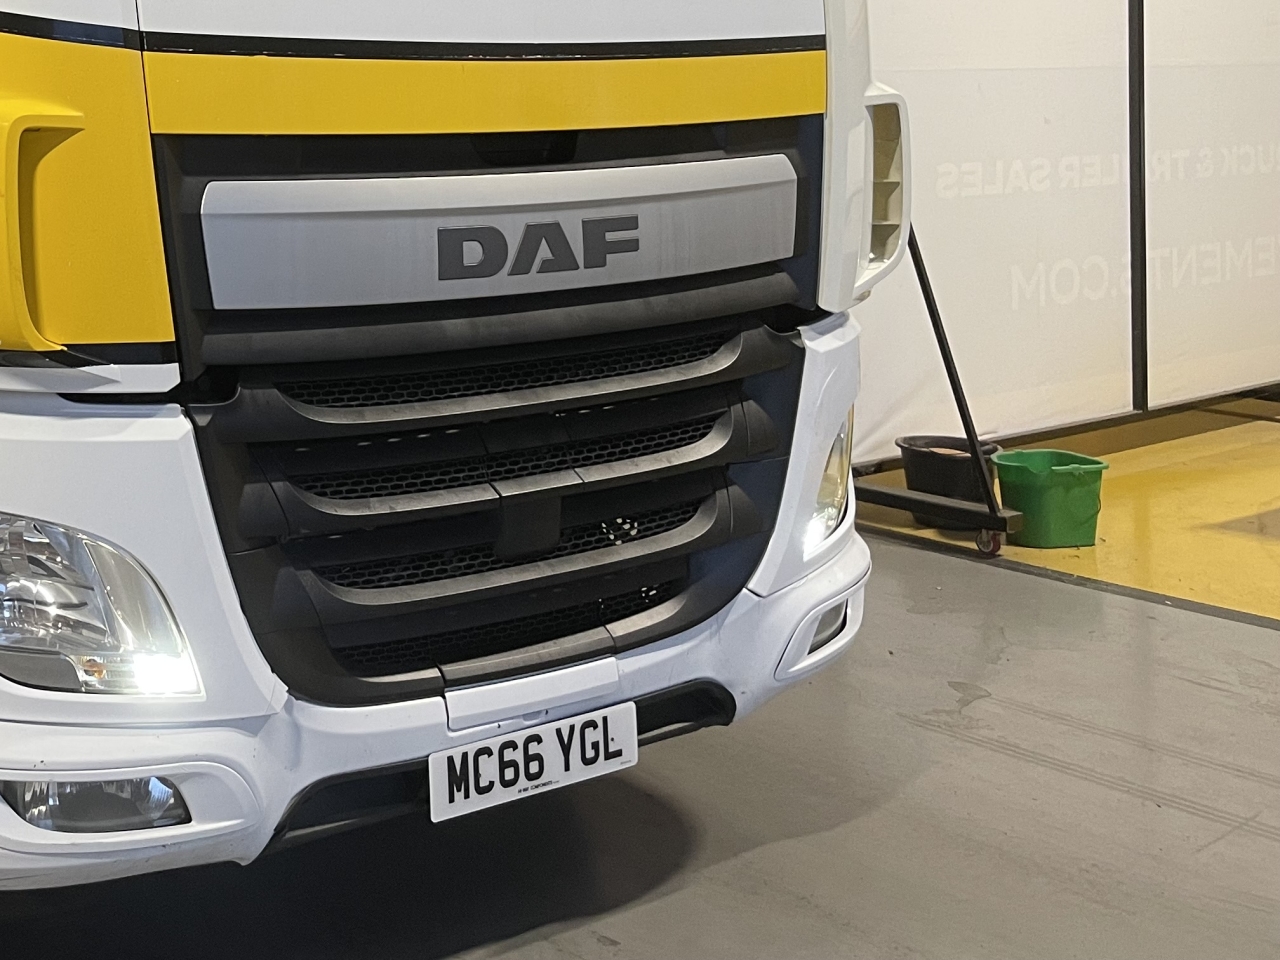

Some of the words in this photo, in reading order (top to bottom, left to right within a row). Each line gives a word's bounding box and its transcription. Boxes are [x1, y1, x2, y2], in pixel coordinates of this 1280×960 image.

[437, 213, 640, 280] DAF
[446, 733, 545, 804] MC66
[555, 715, 623, 772] YGL
